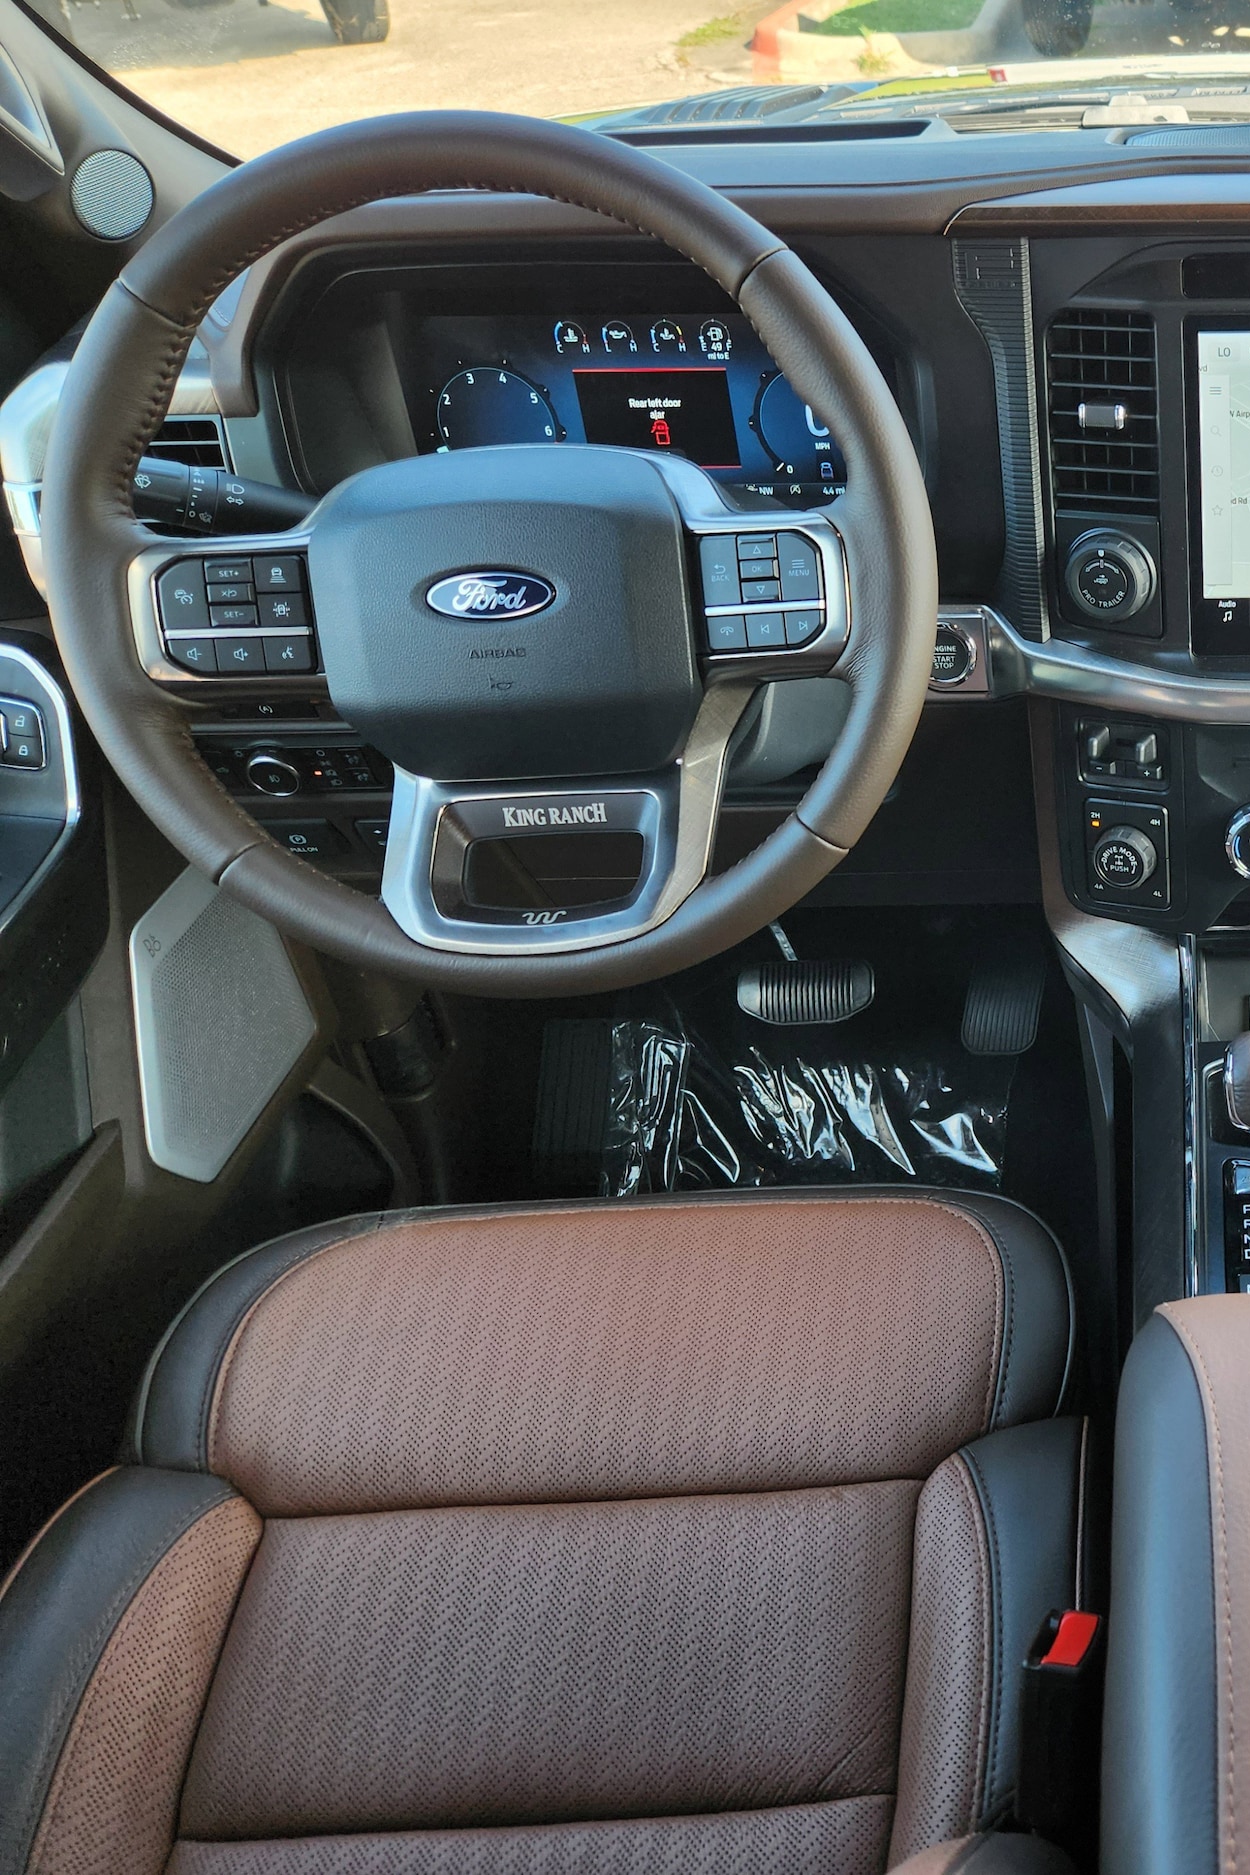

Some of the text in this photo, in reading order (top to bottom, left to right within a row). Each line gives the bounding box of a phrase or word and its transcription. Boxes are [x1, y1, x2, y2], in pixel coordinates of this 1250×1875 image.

[556, 343, 564, 353] C
[582, 343, 591, 353] H
[604, 343, 612, 353] L
[629, 343, 638, 353] H
[653, 343, 661, 353] C
[678, 343, 687, 353] H
[700, 342, 708, 351] E
[710, 341, 723, 351] 49
[1217, 347, 1231, 358] LO
[466, 373, 475, 385] 3
[499, 372, 508, 384] 4
[442, 394, 451, 405] 2
[530, 392, 538, 404] 5
[628, 397, 682, 409] Rear left door
[649, 410, 666, 421] ajar
[443, 426, 450, 438] 1
[544, 425, 553, 437] 6
[815, 441, 831, 450] MPH
[786, 464, 795, 474] 0
[759, 486, 774, 496] NW
[788, 569, 810, 577] MENU
[711, 575, 730, 583] BACK
[452, 578, 526, 611] Ford
[1082, 589, 1126, 608] PRO TRAILER
[1218, 600, 1237, 608] Audio
[468, 648, 526, 659] AIRBAG
[502, 803, 607, 827] KING RANCH
[1090, 811, 1100, 819] 2H
[1149, 818, 1160, 826] 4H
[1101, 846, 1138, 866] DRIVE MODE
[1110, 865, 1129, 873] PUSH
